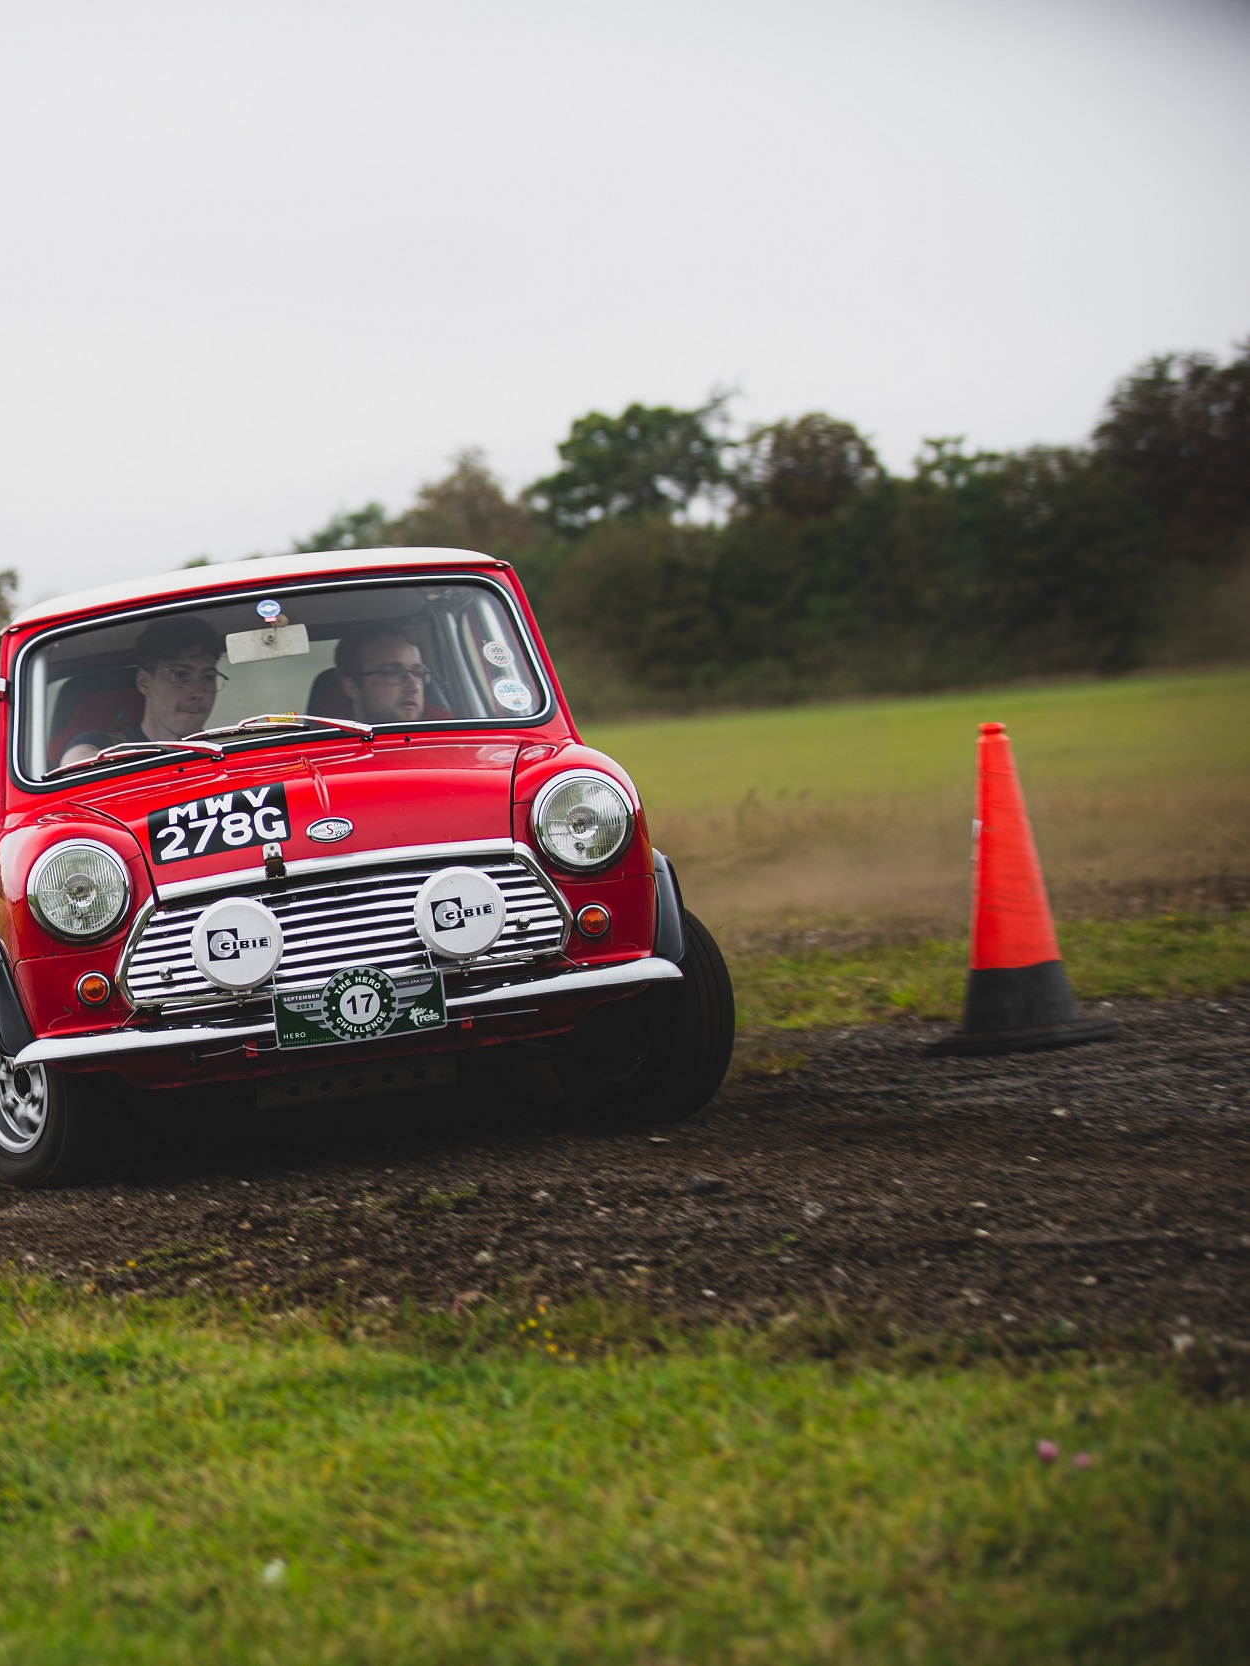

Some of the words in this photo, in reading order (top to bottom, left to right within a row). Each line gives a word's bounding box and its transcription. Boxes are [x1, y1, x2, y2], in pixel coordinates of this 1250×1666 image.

[168, 786, 271, 826] MWV
[156, 806, 288, 861] 278G
[333, 979, 352, 995] THE
[355, 976, 381, 990] HERO
[396, 977, 432, 986] HERO-ERA.COM
[283, 993, 320, 1003] SEPTEMBER
[346, 992, 374, 1015] 17
[336, 1011, 387, 1033] CHALLENGE
[419, 1009, 440, 1023] reis
[283, 1031, 307, 1040] HERO
